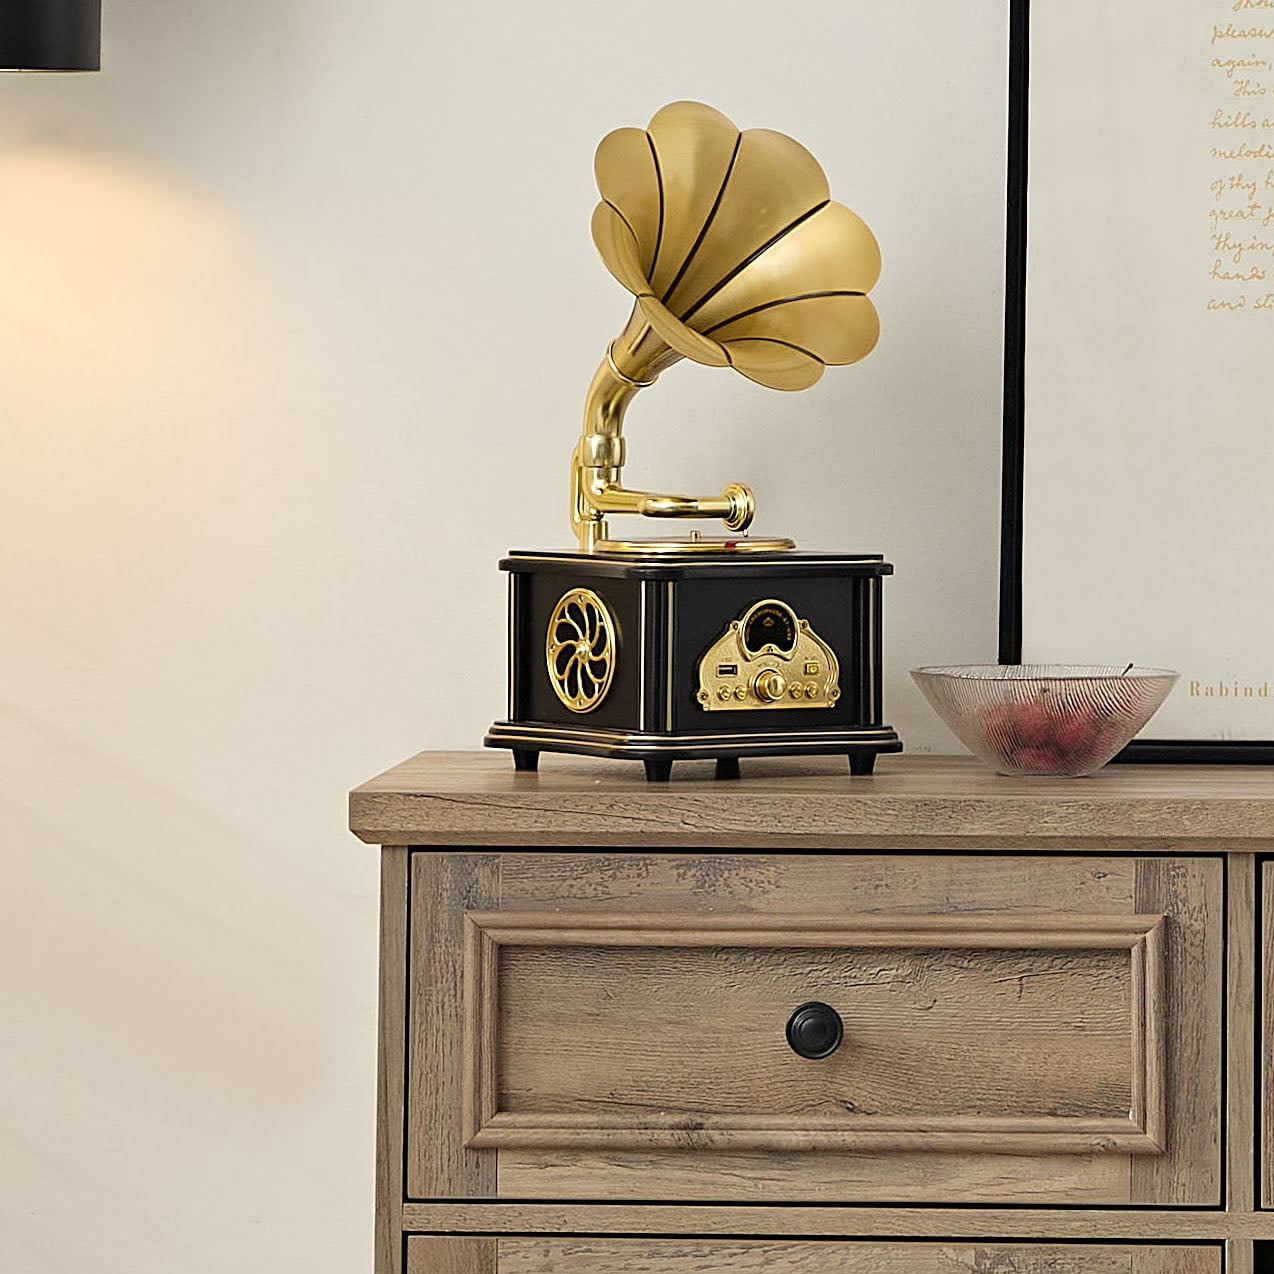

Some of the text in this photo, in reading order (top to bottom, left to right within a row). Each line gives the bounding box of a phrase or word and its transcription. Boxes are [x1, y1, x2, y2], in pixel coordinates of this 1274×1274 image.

[1211, 53, 1272, 77] again,
[1233, 79, 1266, 96] This
[1209, 109, 1257, 128] hills
[1210, 178, 1226, 201] of
[1228, 175, 1257, 200] thy
[1209, 204, 1261, 233] great
[1211, 232, 1243, 263] Thy
[1209, 260, 1265, 280] hands
[1207, 296, 1246, 309] and
